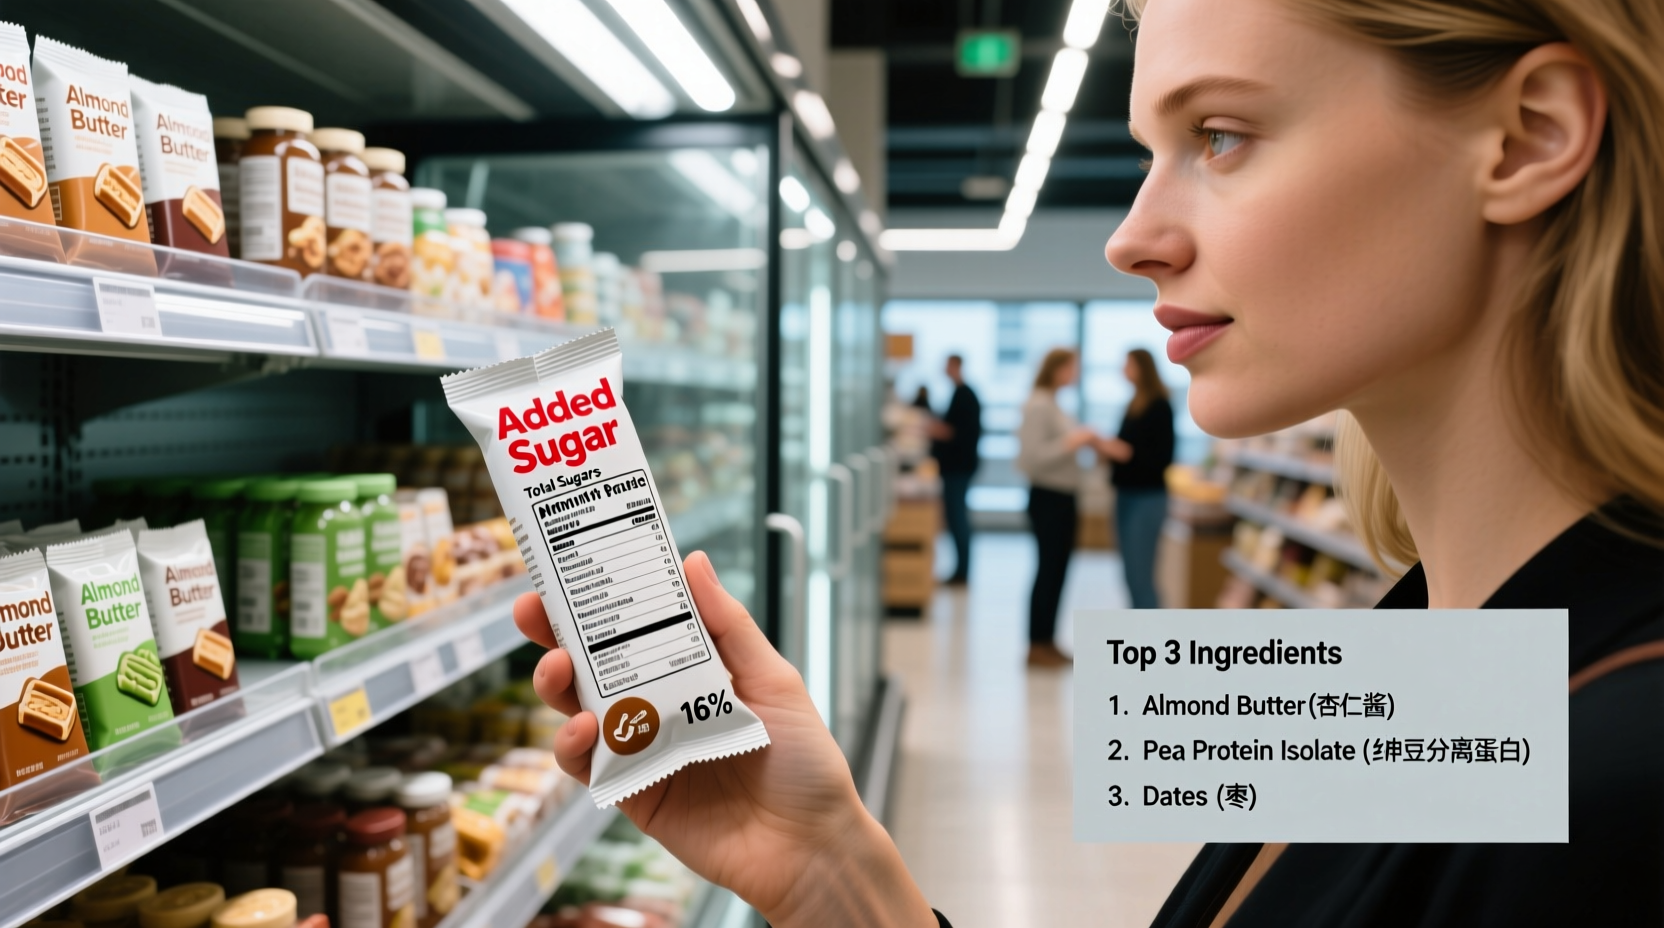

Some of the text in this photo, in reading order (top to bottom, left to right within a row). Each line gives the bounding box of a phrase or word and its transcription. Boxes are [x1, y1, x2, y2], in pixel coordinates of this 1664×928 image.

[66, 84, 129, 119] Almond
[70, 108, 128, 140] Butter
[160, 134, 210, 163] Butter
[498, 377, 617, 441] Added
[508, 418, 618, 474] Sugar
[556, 468, 602, 487] Sugars
[81, 572, 140, 606] Almond
[166, 562, 214, 585] Almond
[168, 583, 214, 607] Butter
[85, 601, 142, 630] Butter
[680, 689, 733, 724] 16%
